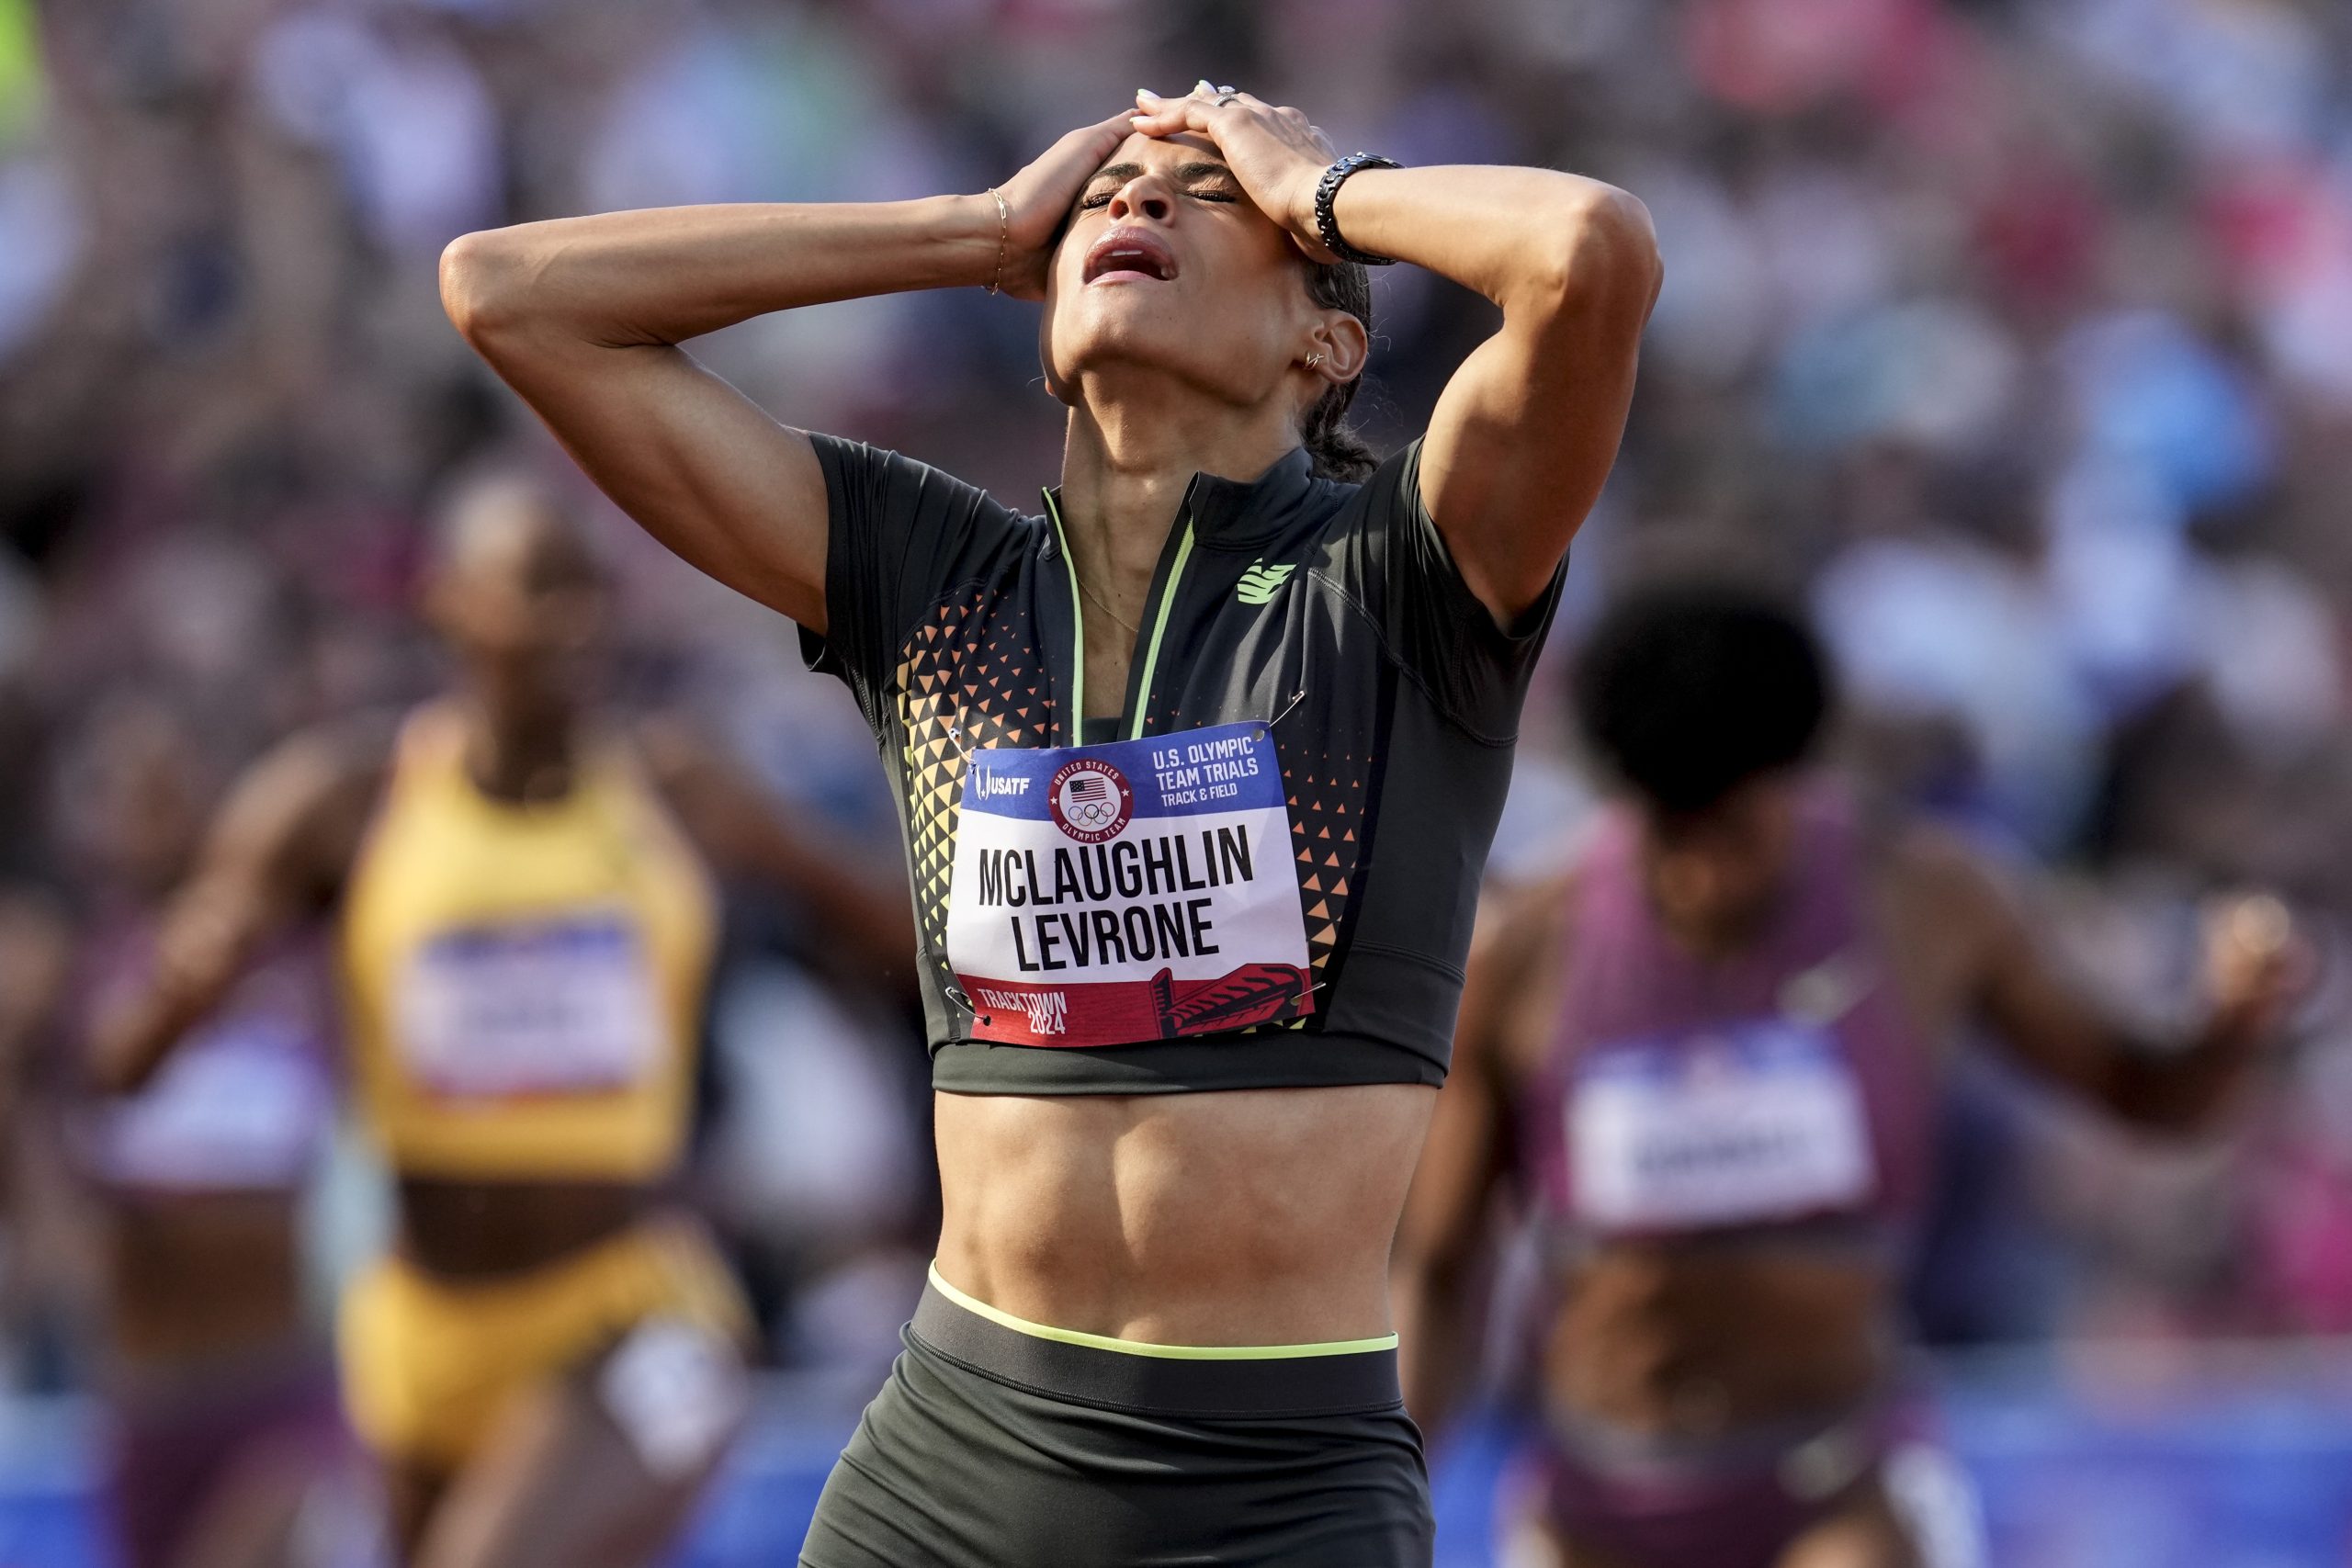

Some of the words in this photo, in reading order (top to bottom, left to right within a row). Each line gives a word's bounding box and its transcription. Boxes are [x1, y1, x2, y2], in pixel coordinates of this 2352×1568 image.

[1152, 748, 1185, 770] U.S.
[1187, 736, 1254, 764] OLYMPIC
[990, 776, 1030, 795] USATF
[1054, 761, 1081, 786] UNITED
[1085, 761, 1120, 780] STATES
[1156, 767, 1201, 791] TEAM
[1203, 757, 1259, 784] TRIALS
[1161, 789, 1198, 807] TRACK
[1199, 787, 1208, 801] &
[1209, 782, 1238, 799] FIELD
[1062, 822, 1101, 841] OLYMPIC
[1105, 817, 1126, 838] TEAM
[978, 824, 1254, 908] MCLAUGHLIN
[1011, 897, 1220, 973] LEVRONE
[977, 987, 1068, 1016] TRACKTOWN
[1027, 1010, 1066, 1035] 2024
